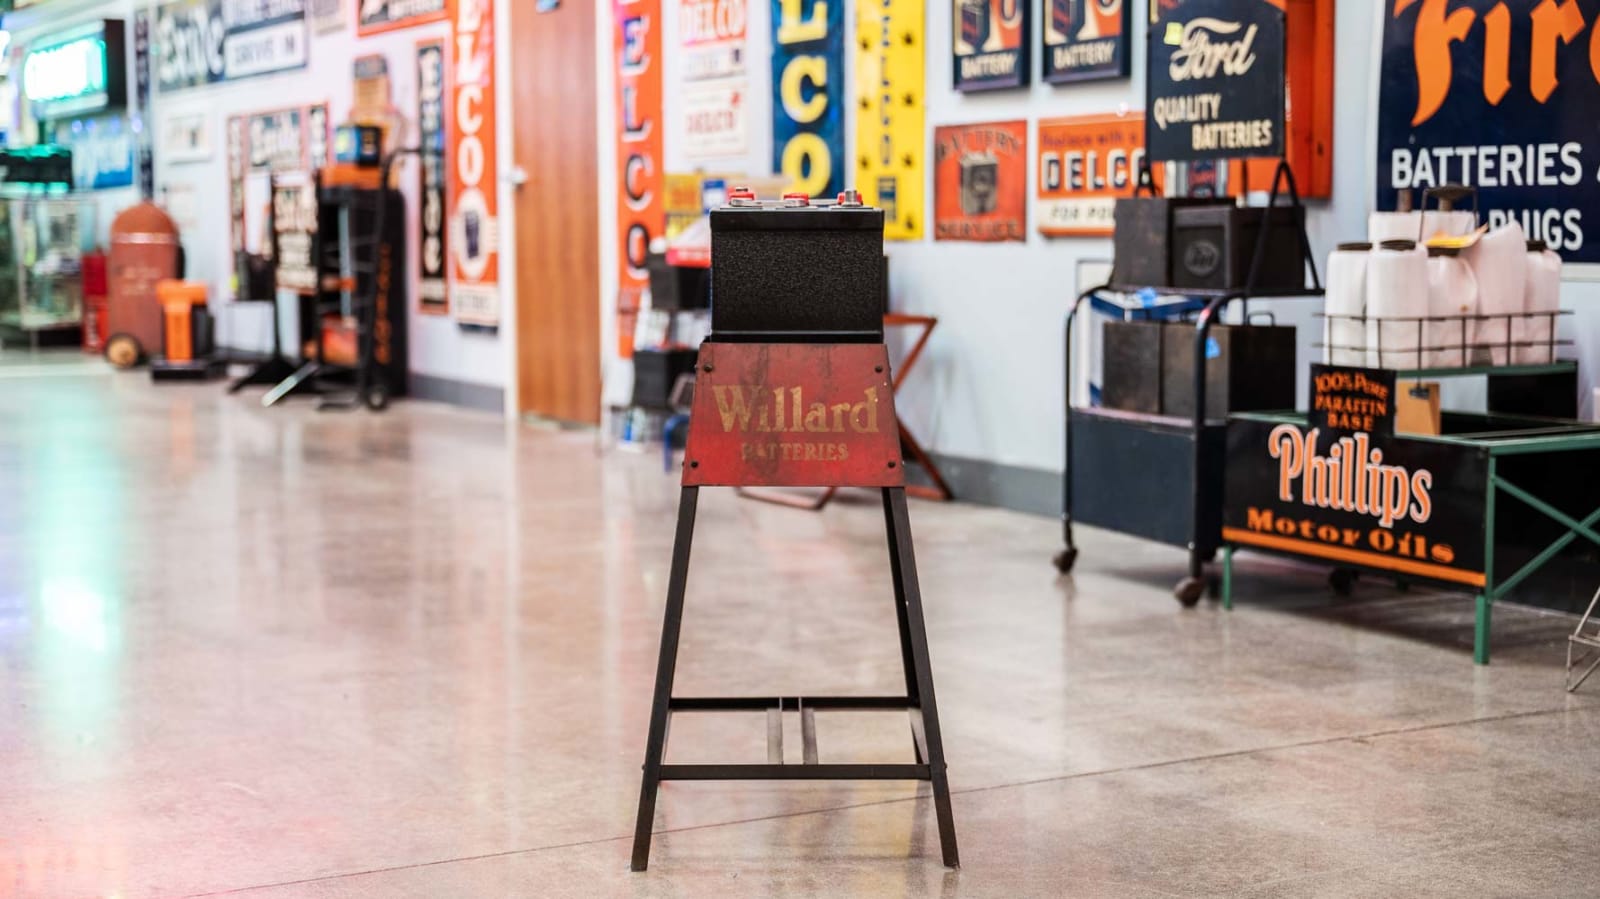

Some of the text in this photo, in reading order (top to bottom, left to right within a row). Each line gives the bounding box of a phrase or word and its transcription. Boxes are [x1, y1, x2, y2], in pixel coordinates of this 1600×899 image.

[961, 53, 1017, 79] BATTERY
[1053, 41, 1115, 70] BATTERY
[1169, 17, 1258, 82] Ford
[1393, 0, 1600, 128] Fir
[1154, 93, 1221, 130] QUALITY
[621, 0, 654, 282] ELCO
[935, 126, 1020, 160] BATTERY
[1192, 119, 1273, 151] BATTERIES
[1391, 142, 1583, 189] BATTERIES
[937, 219, 1018, 239] SERVICE
[712, 384, 879, 433] Willard
[1315, 393, 1387, 416] PARAFFIN
[1327, 411, 1373, 431] BASE
[742, 442, 849, 462] BATTERIES
[1268, 424, 1432, 528] Phillips
[1247, 507, 1455, 563] Motor Oils
